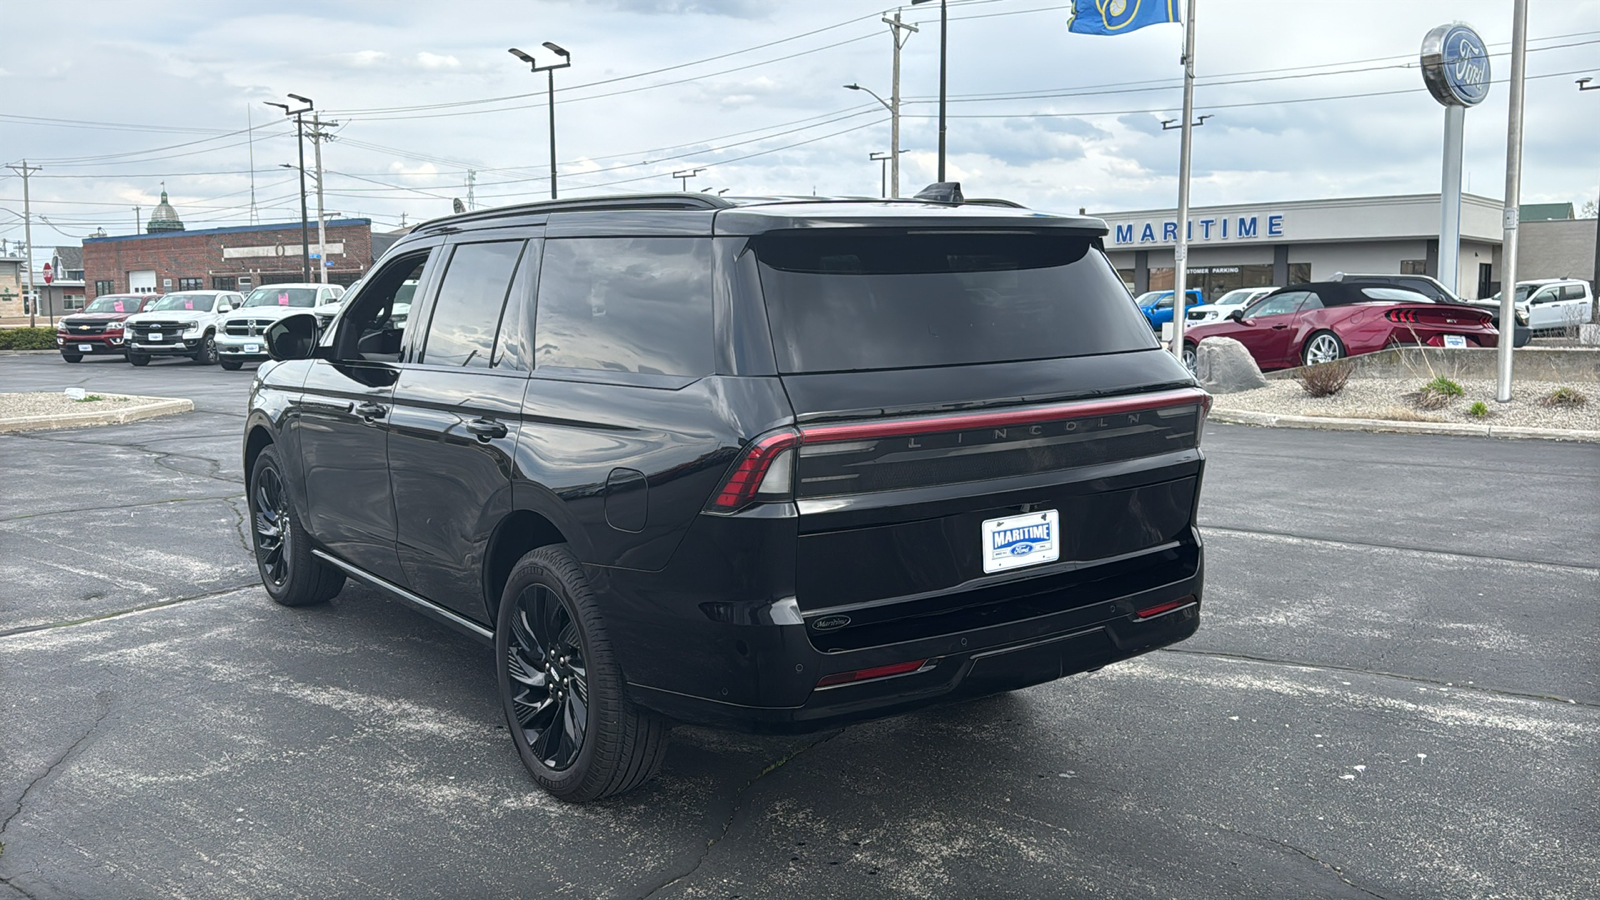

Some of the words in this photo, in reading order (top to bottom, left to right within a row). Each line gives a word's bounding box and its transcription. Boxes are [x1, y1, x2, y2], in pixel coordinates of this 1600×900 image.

[1455, 38, 1486, 91] Ford
[1115, 214, 1284, 244] MARITIME
[908, 413, 1141, 448] LINCOLN
[994, 524, 1050, 549] MARITIME
[1013, 544, 1031, 555] Ford
